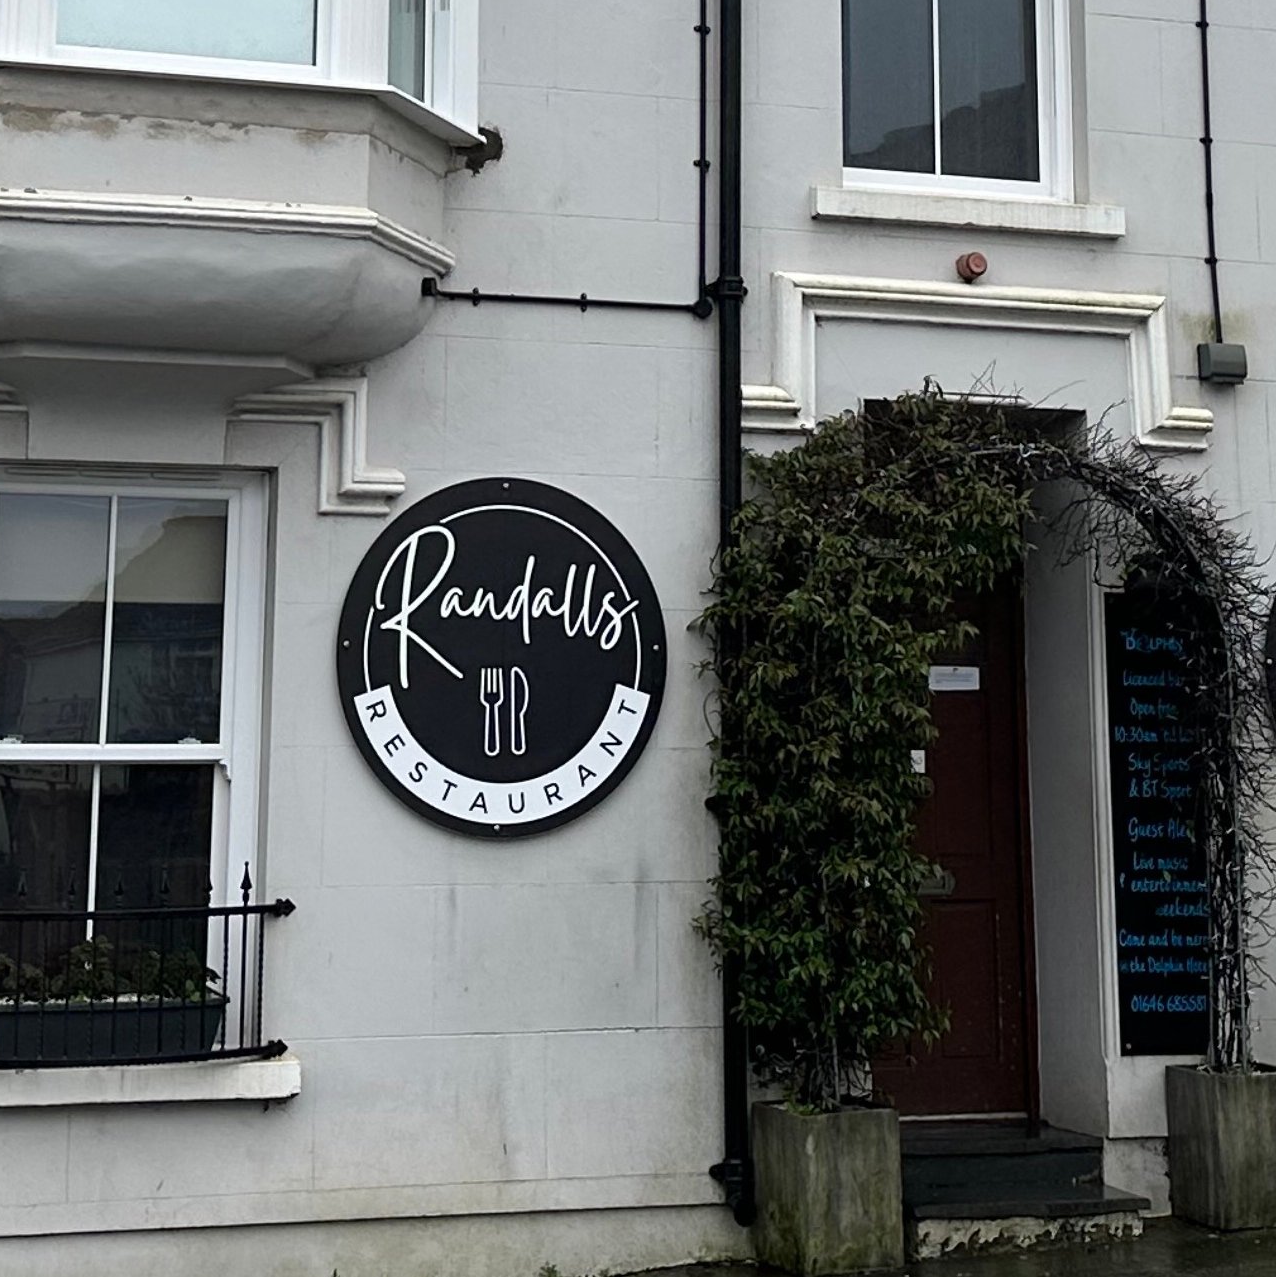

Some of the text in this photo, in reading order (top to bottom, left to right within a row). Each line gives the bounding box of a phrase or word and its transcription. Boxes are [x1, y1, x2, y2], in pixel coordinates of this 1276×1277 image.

[375, 525, 640, 689] Randalls
[365, 698, 639, 814] RESTAURANT
[1128, 752, 1151, 777] Sky
[1142, 779, 1158, 797] BT
[1128, 817, 1164, 842] Guest
[1119, 928, 1146, 946] Come
[1148, 928, 1168, 946] and
[1130, 995, 1164, 1012] 01646
